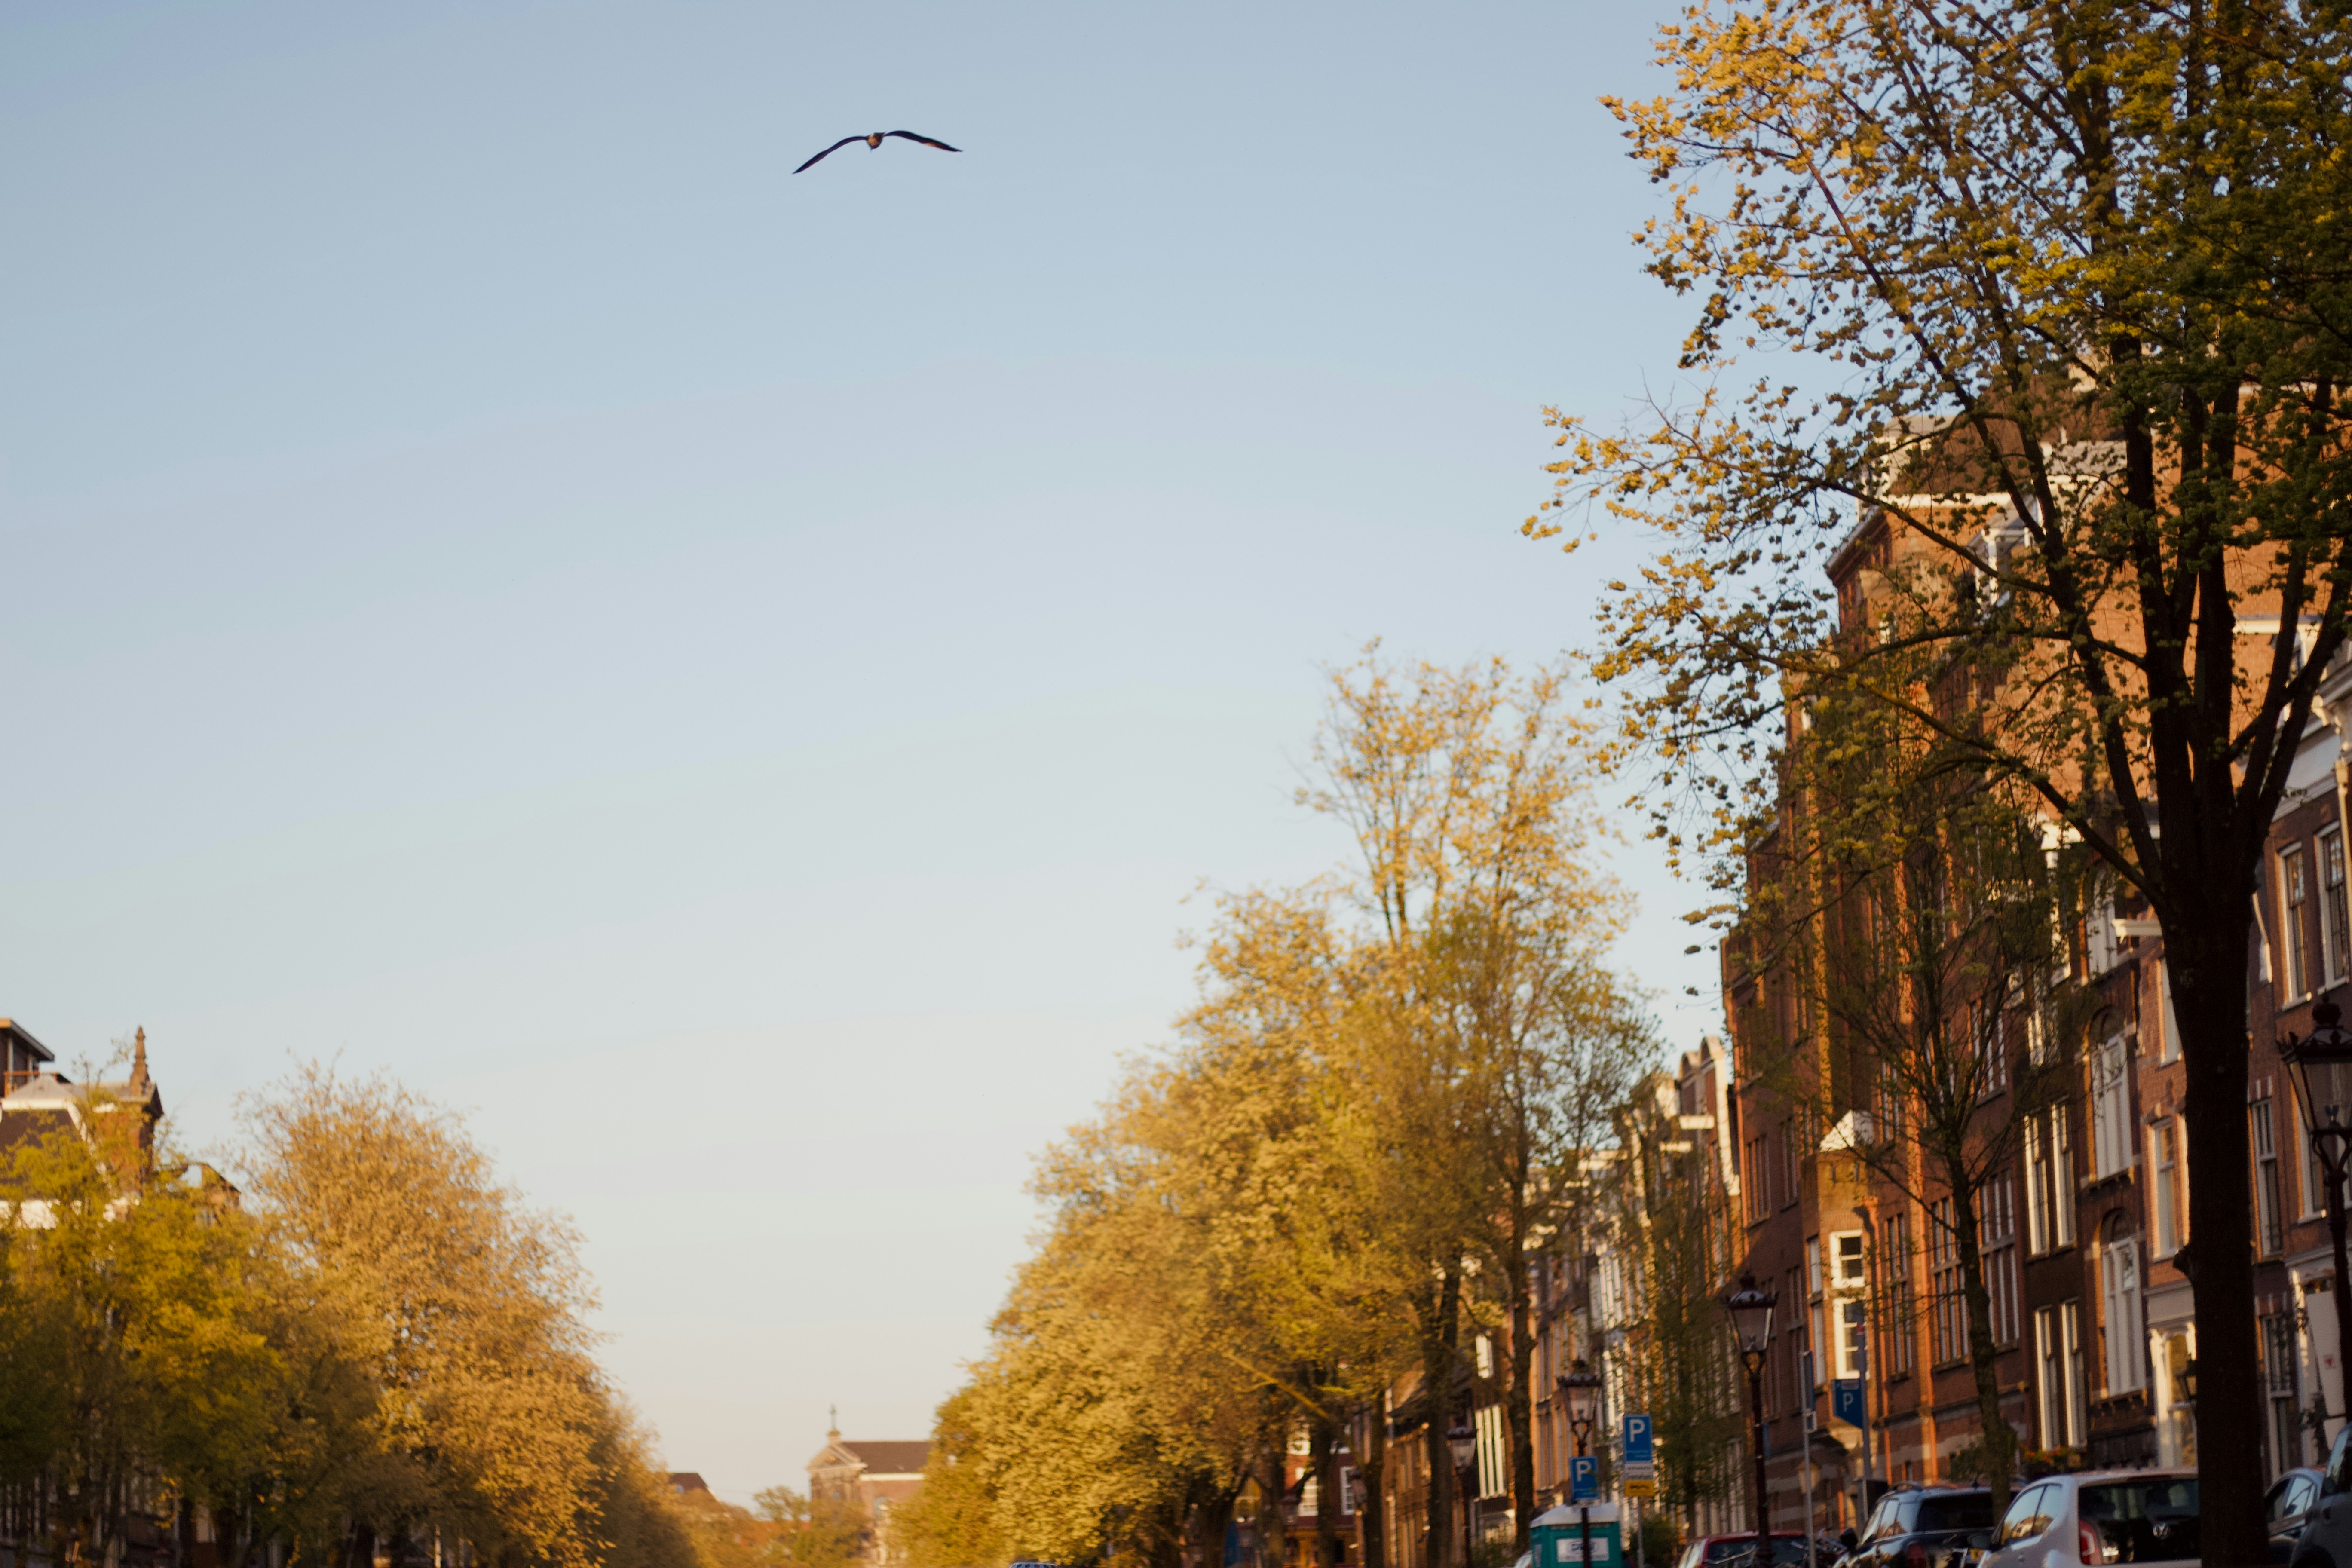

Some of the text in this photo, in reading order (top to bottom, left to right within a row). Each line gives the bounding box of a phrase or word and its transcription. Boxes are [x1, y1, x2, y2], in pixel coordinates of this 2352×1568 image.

[1843, 1393, 1853, 1412] P
[1629, 1419, 1645, 1443] P
[1576, 1461, 1591, 1482] P
